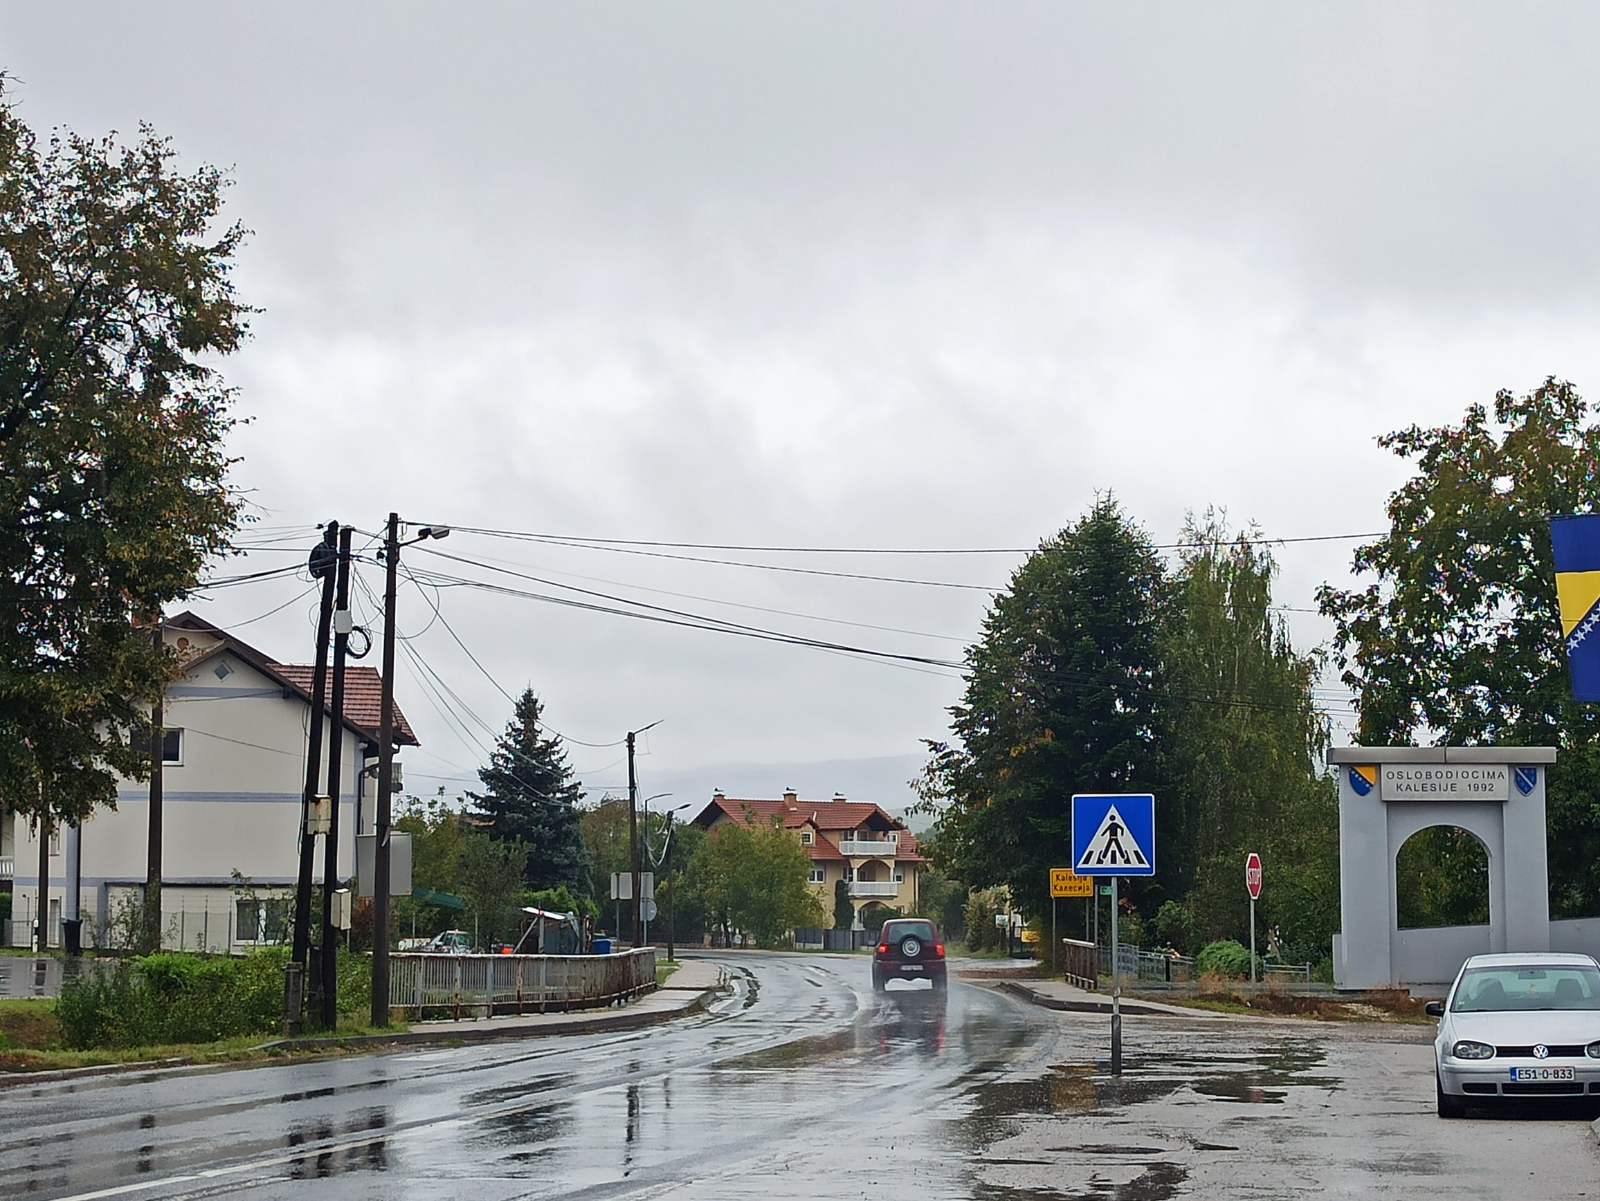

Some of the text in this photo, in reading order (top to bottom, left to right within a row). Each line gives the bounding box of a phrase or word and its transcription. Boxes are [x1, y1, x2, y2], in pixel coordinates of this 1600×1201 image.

[1386, 770, 1505, 780] OSLOBODIOCIMA
[1396, 783, 1494, 792] KALESIJE 1992
[1248, 868, 1260, 885] STOP
